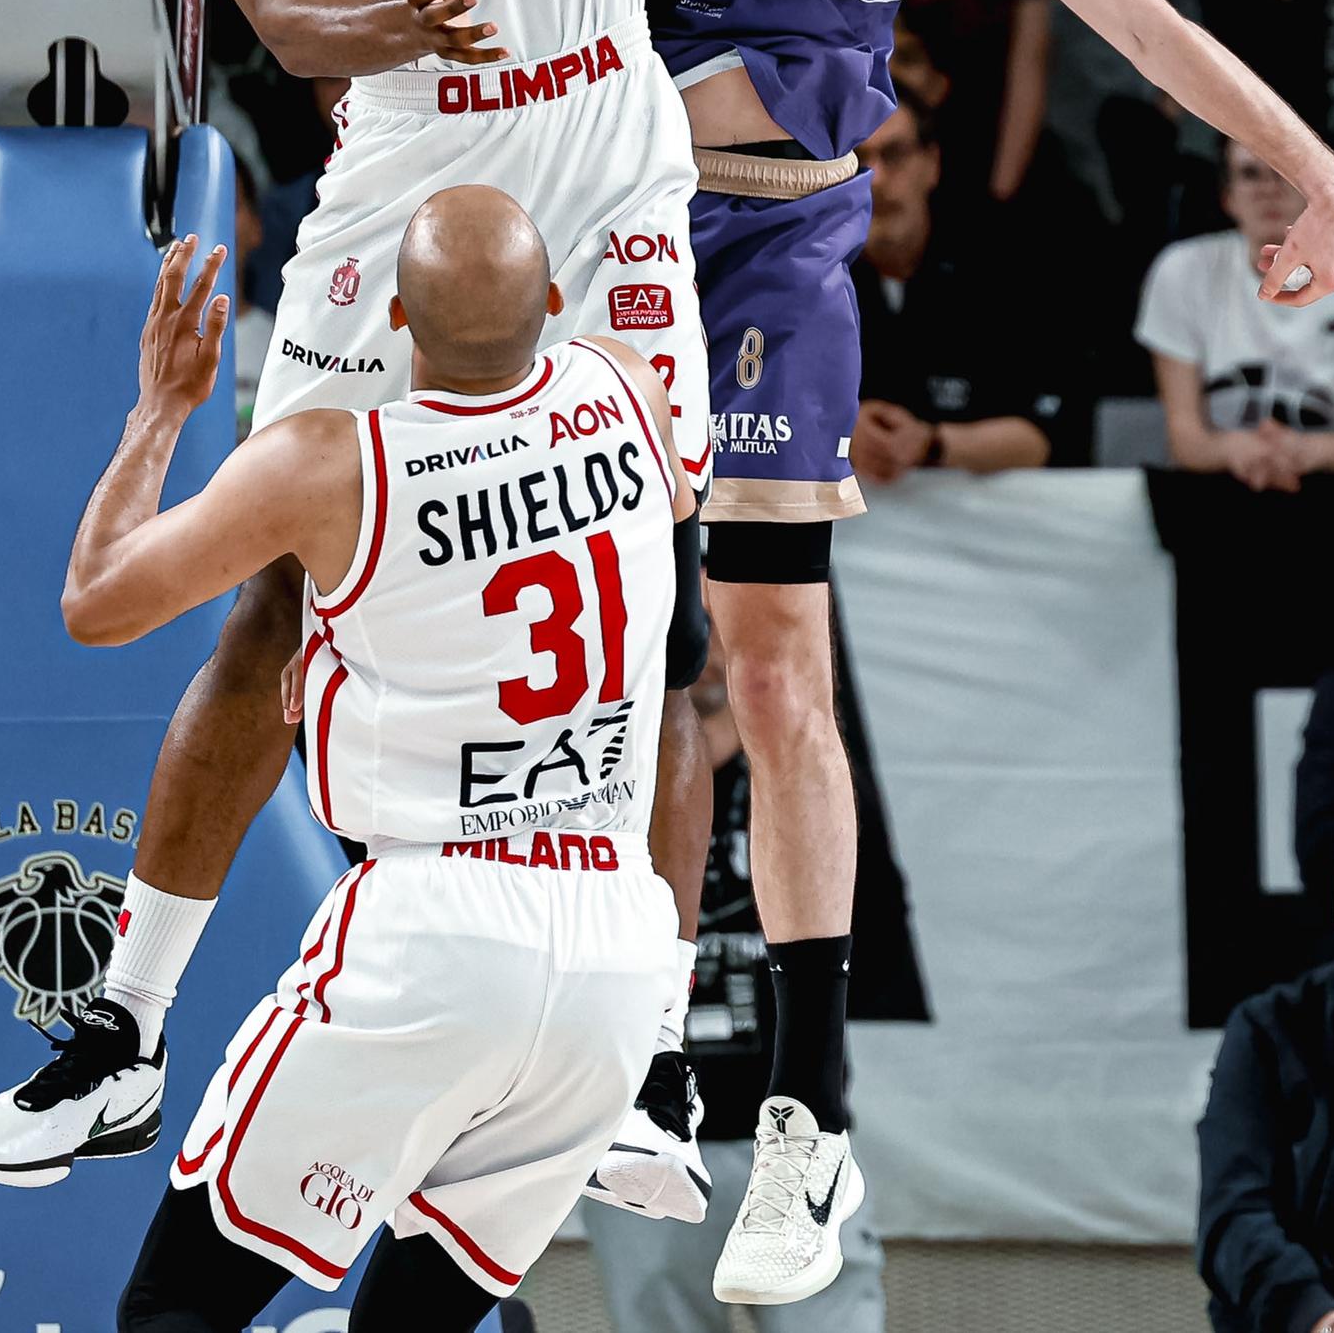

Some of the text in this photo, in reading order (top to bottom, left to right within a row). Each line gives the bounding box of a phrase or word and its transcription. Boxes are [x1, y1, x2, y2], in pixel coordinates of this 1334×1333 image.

[437, 35, 624, 115] OLIMPIA
[603, 230, 680, 265] AON
[329, 264, 362, 299] 90
[613, 288, 666, 310] EA7
[616, 315, 668, 326] EYEWEAR
[282, 338, 386, 373] DRIVALIA
[736, 327, 765, 390] 8
[405, 395, 624, 478] DRIVALIA AON
[730, 412, 793, 442] ITAS
[730, 440, 779, 455] MUTUA
[417, 441, 645, 567] SHIELDS
[481, 530, 628, 726] 31
[459, 700, 635, 808] EA7
[52, 798, 139, 849] BAS
[440, 830, 619, 872] MILANO
[307, 1161, 375, 1202] ACQUA DI
